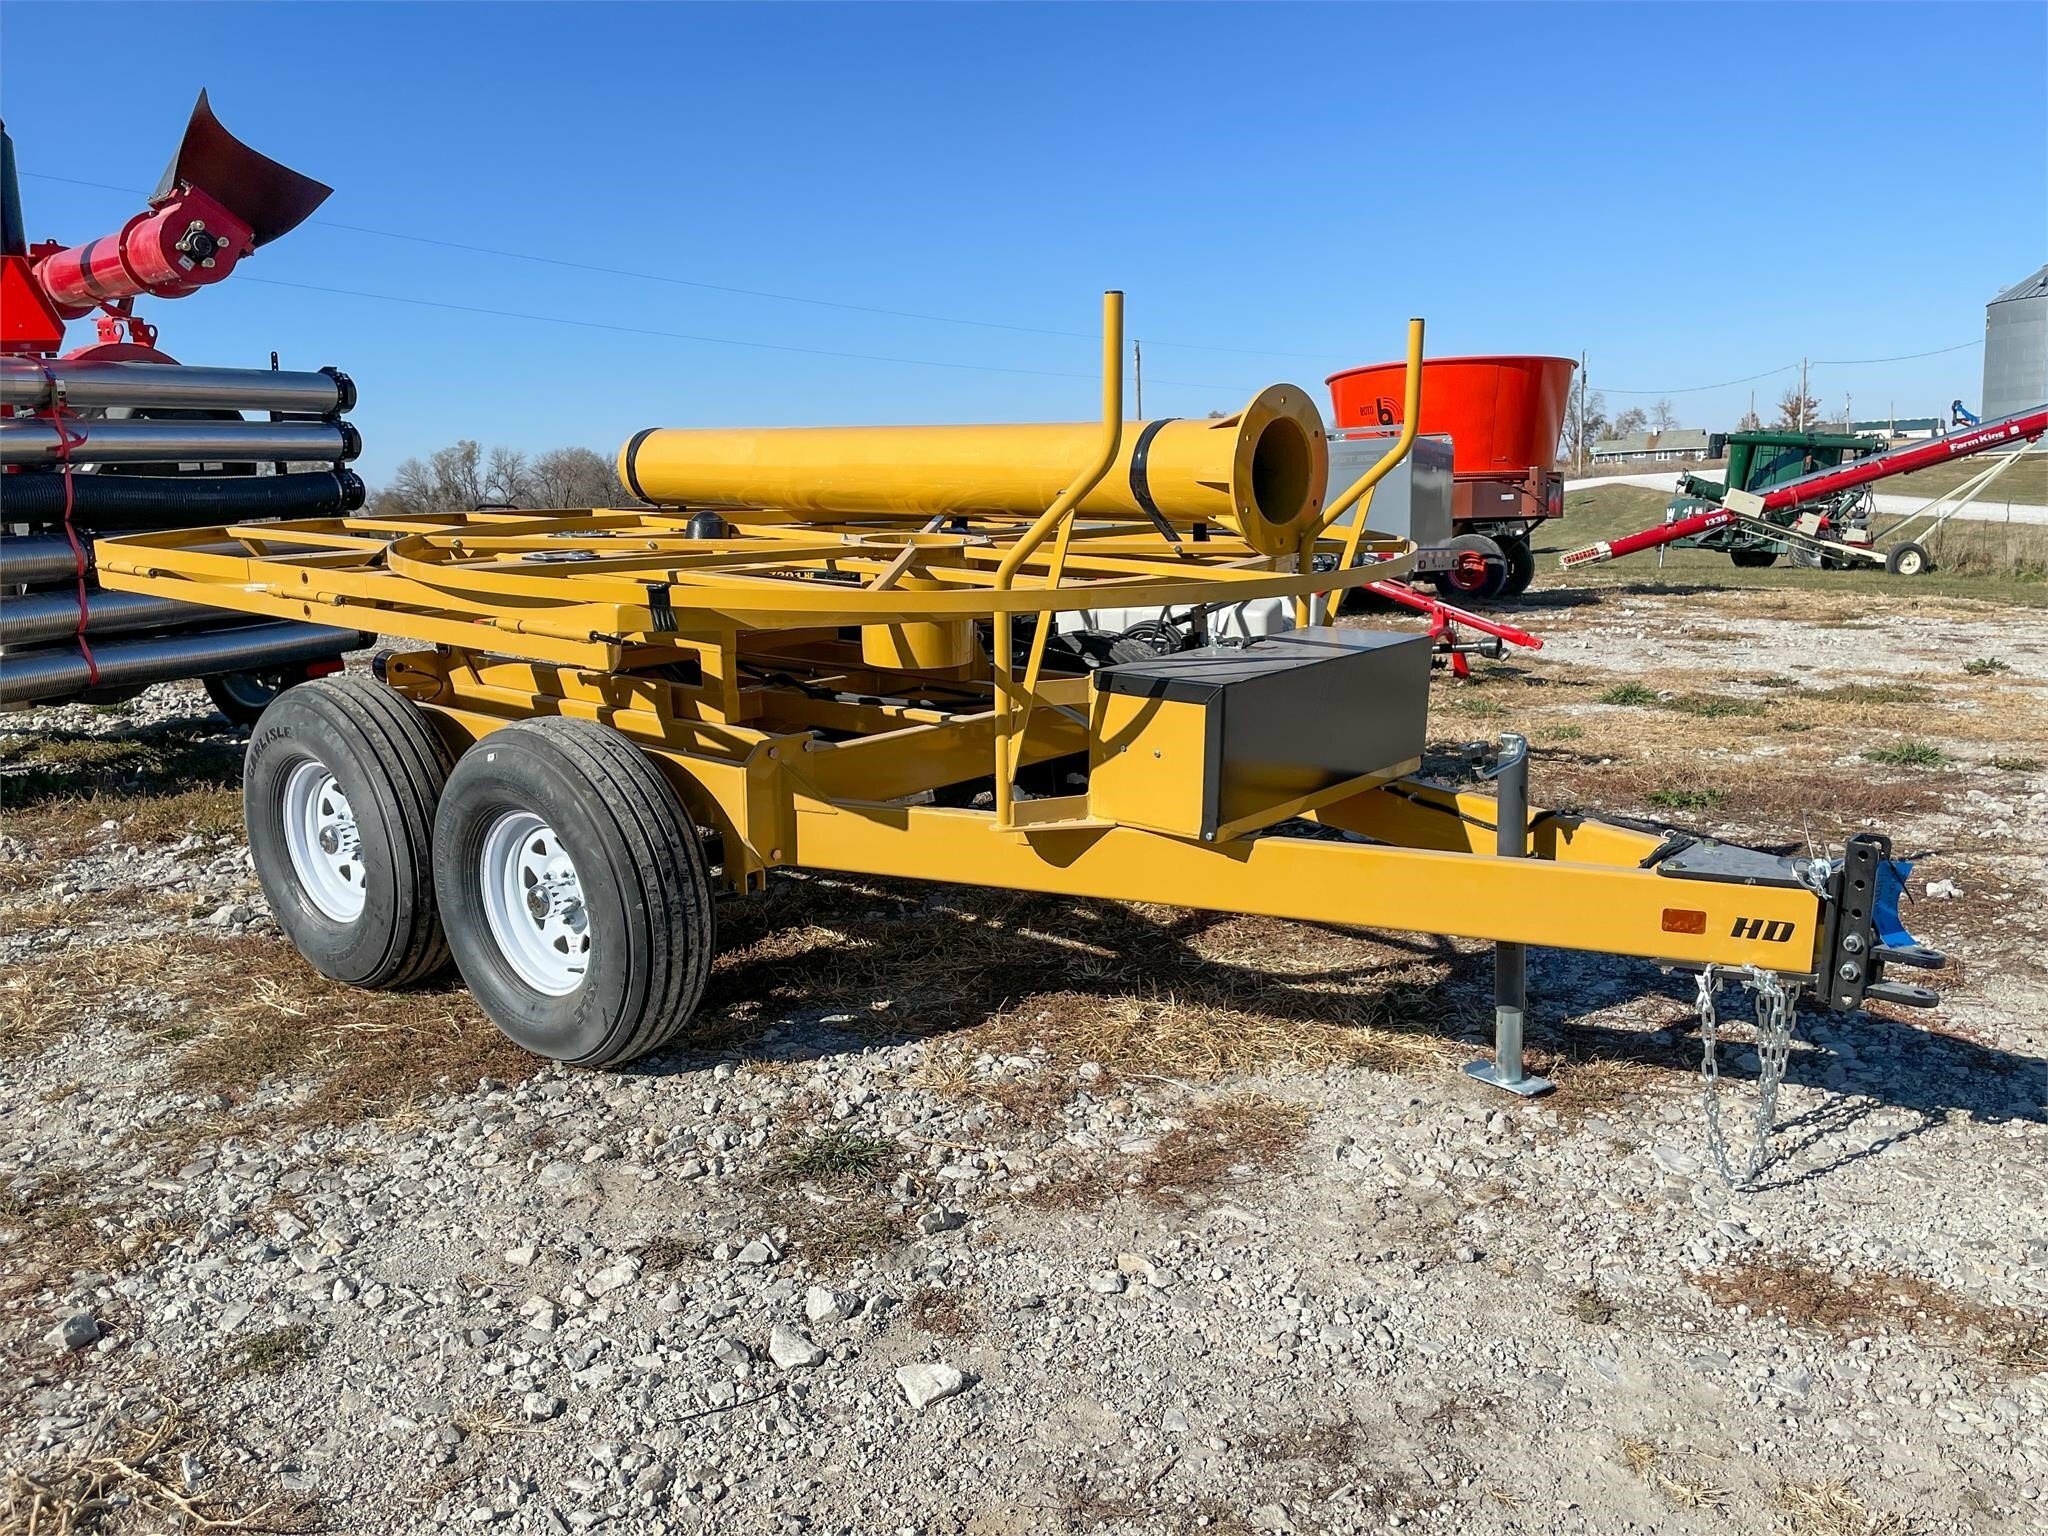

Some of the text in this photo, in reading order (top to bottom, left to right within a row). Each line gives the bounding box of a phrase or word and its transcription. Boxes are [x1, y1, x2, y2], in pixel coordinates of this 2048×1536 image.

[1949, 431, 2005, 451] Farm King
[1704, 514, 1728, 526] 1336
[247, 726, 293, 780] CARLISLE
[1730, 916, 1796, 943] HD
